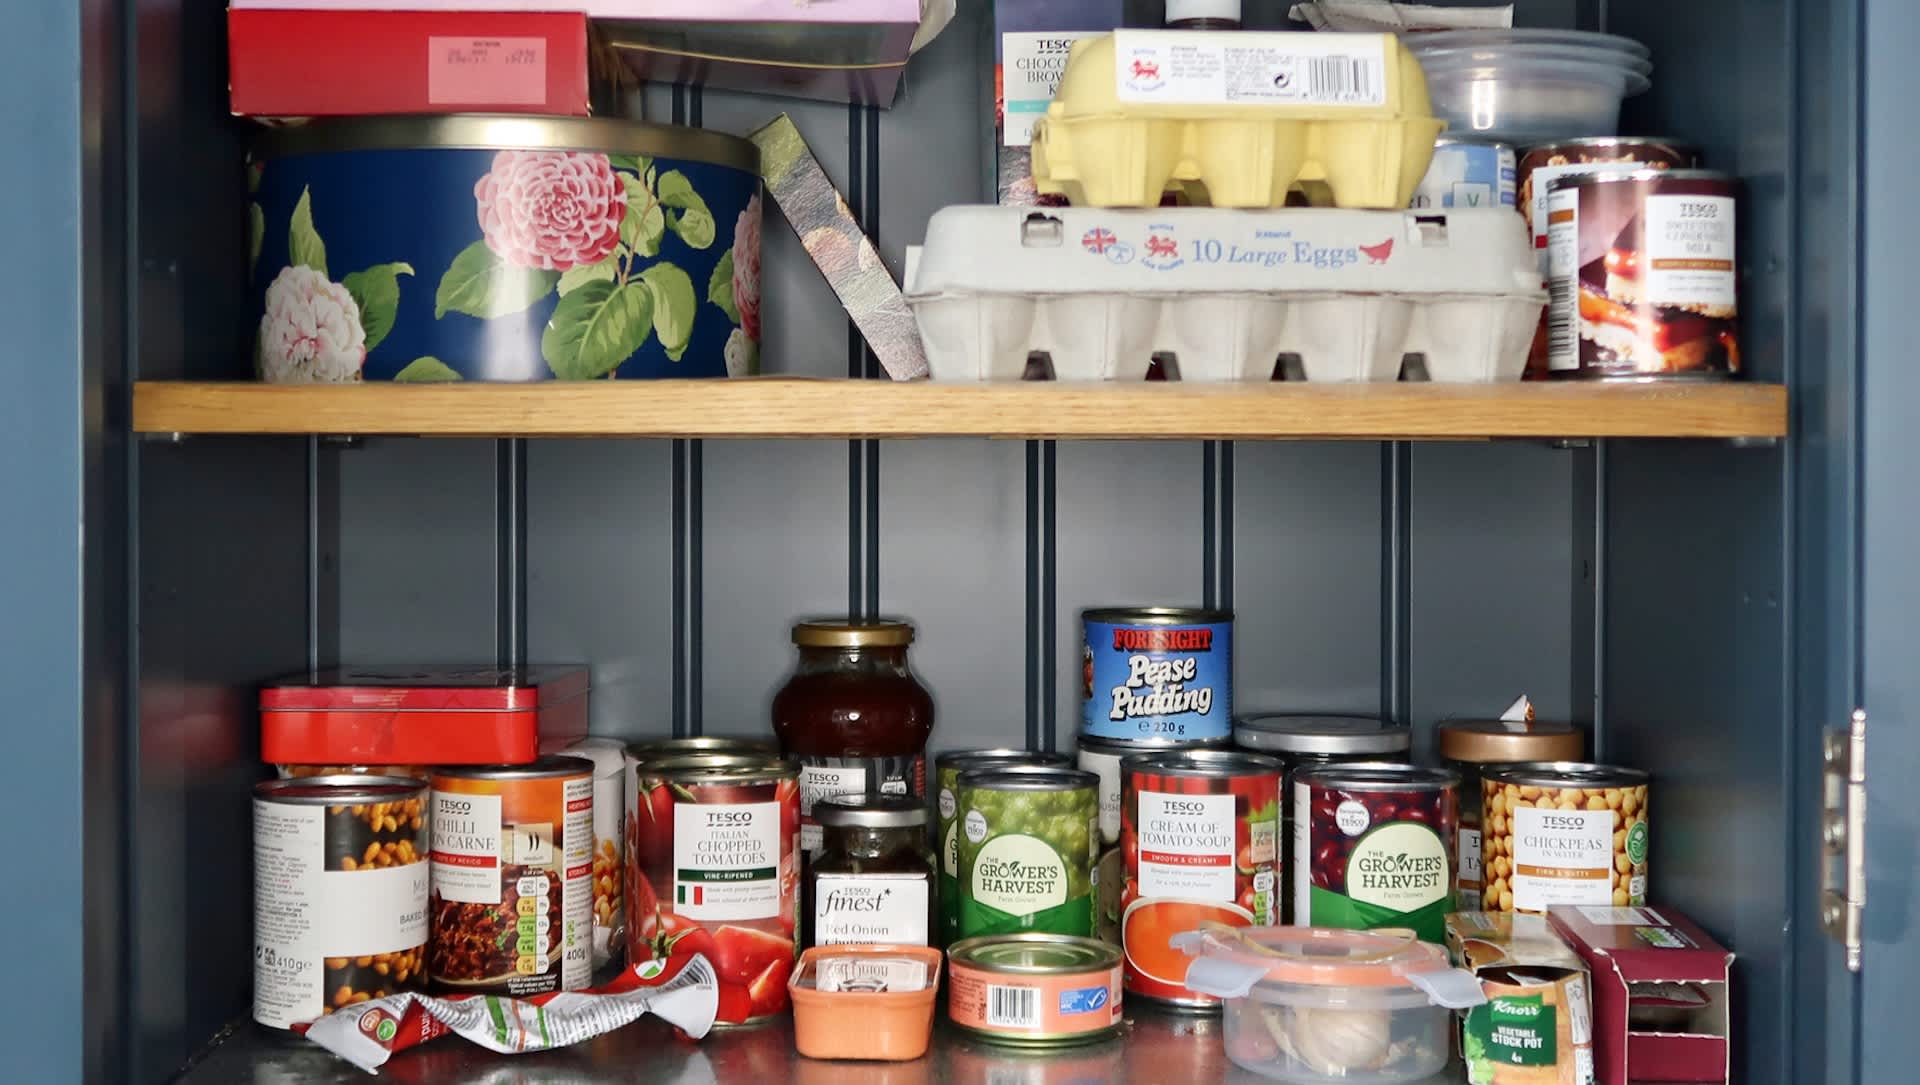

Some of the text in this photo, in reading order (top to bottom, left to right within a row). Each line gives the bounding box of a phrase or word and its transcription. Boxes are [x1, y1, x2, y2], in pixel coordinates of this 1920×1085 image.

[1037, 40, 1074, 49] TESC
[1192, 239, 1360, 269] 10 Large Eggs
[1113, 628, 1212, 650] FORESIGHT
[1126, 655, 1197, 688] Pease
[1109, 683, 1213, 721] Pudding
[1153, 722, 1177, 732] 220
[808, 773, 840, 784] TESCO
[439, 799, 472, 812] TESCO
[1163, 801, 1205, 812] TESCO
[706, 812, 753, 823] TESCO
[1542, 816, 1585, 826] TESCO
[1150, 820, 1218, 834] CREAM OF
[711, 831, 749, 839] ITALIAN
[1142, 832, 1232, 848] TOMATO SOUP
[447, 834, 496, 851] CARNE
[697, 840, 761, 853] CHOPPED
[1523, 837, 1602, 850] CHICKPEAS
[692, 852, 766, 865] TOMATOES
[1359, 854, 1442, 873] GROWER'S
[980, 862, 1058, 880] GROWER'S
[982, 879, 1055, 893] HARVEST
[1362, 873, 1440, 889] HARVEST
[820, 889, 884, 917] finest
[851, 924, 889, 935] Onion
[277, 957, 302, 972] 410g
[1492, 999, 1541, 1016] Knorr
[1498, 1026, 1536, 1038] VEGETABLE
[1491, 1033, 1543, 1049] STOCK POT
